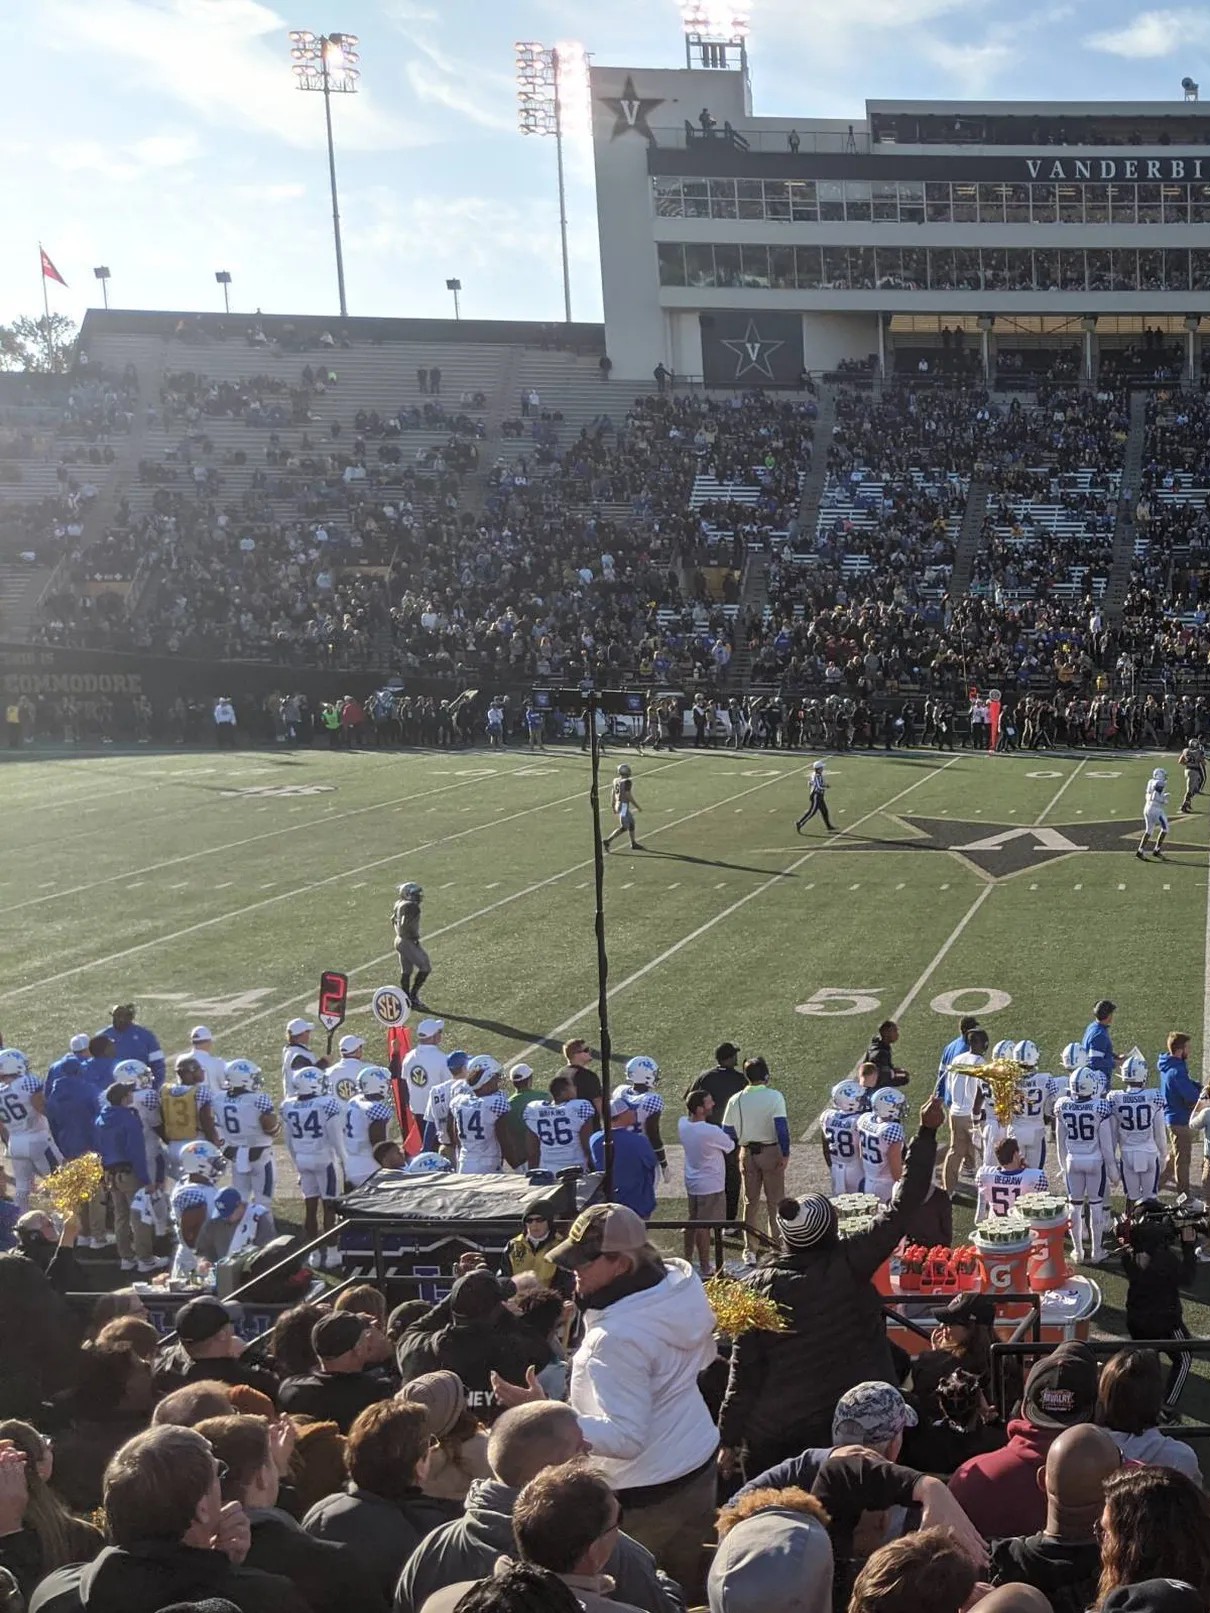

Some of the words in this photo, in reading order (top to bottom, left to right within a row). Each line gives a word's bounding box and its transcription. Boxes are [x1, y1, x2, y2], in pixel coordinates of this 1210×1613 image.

[618, 101, 640, 127] V
[4, 673, 142, 694] COMMODORE
[321, 974, 345, 1016] 2
[377, 994, 400, 1020] SEC
[287, 1110, 324, 1139] 34
[457, 1108, 486, 1140] 14
[536, 1117, 574, 1147] 66
[1062, 1113, 1095, 1141] 36
[1119, 1104, 1152, 1131] 30
[825, 1127, 855, 1158] 28
[859, 1130, 884, 1165] 25
[991, 1186, 1021, 1218] 51
[990, 1264, 1012, 1288] G
